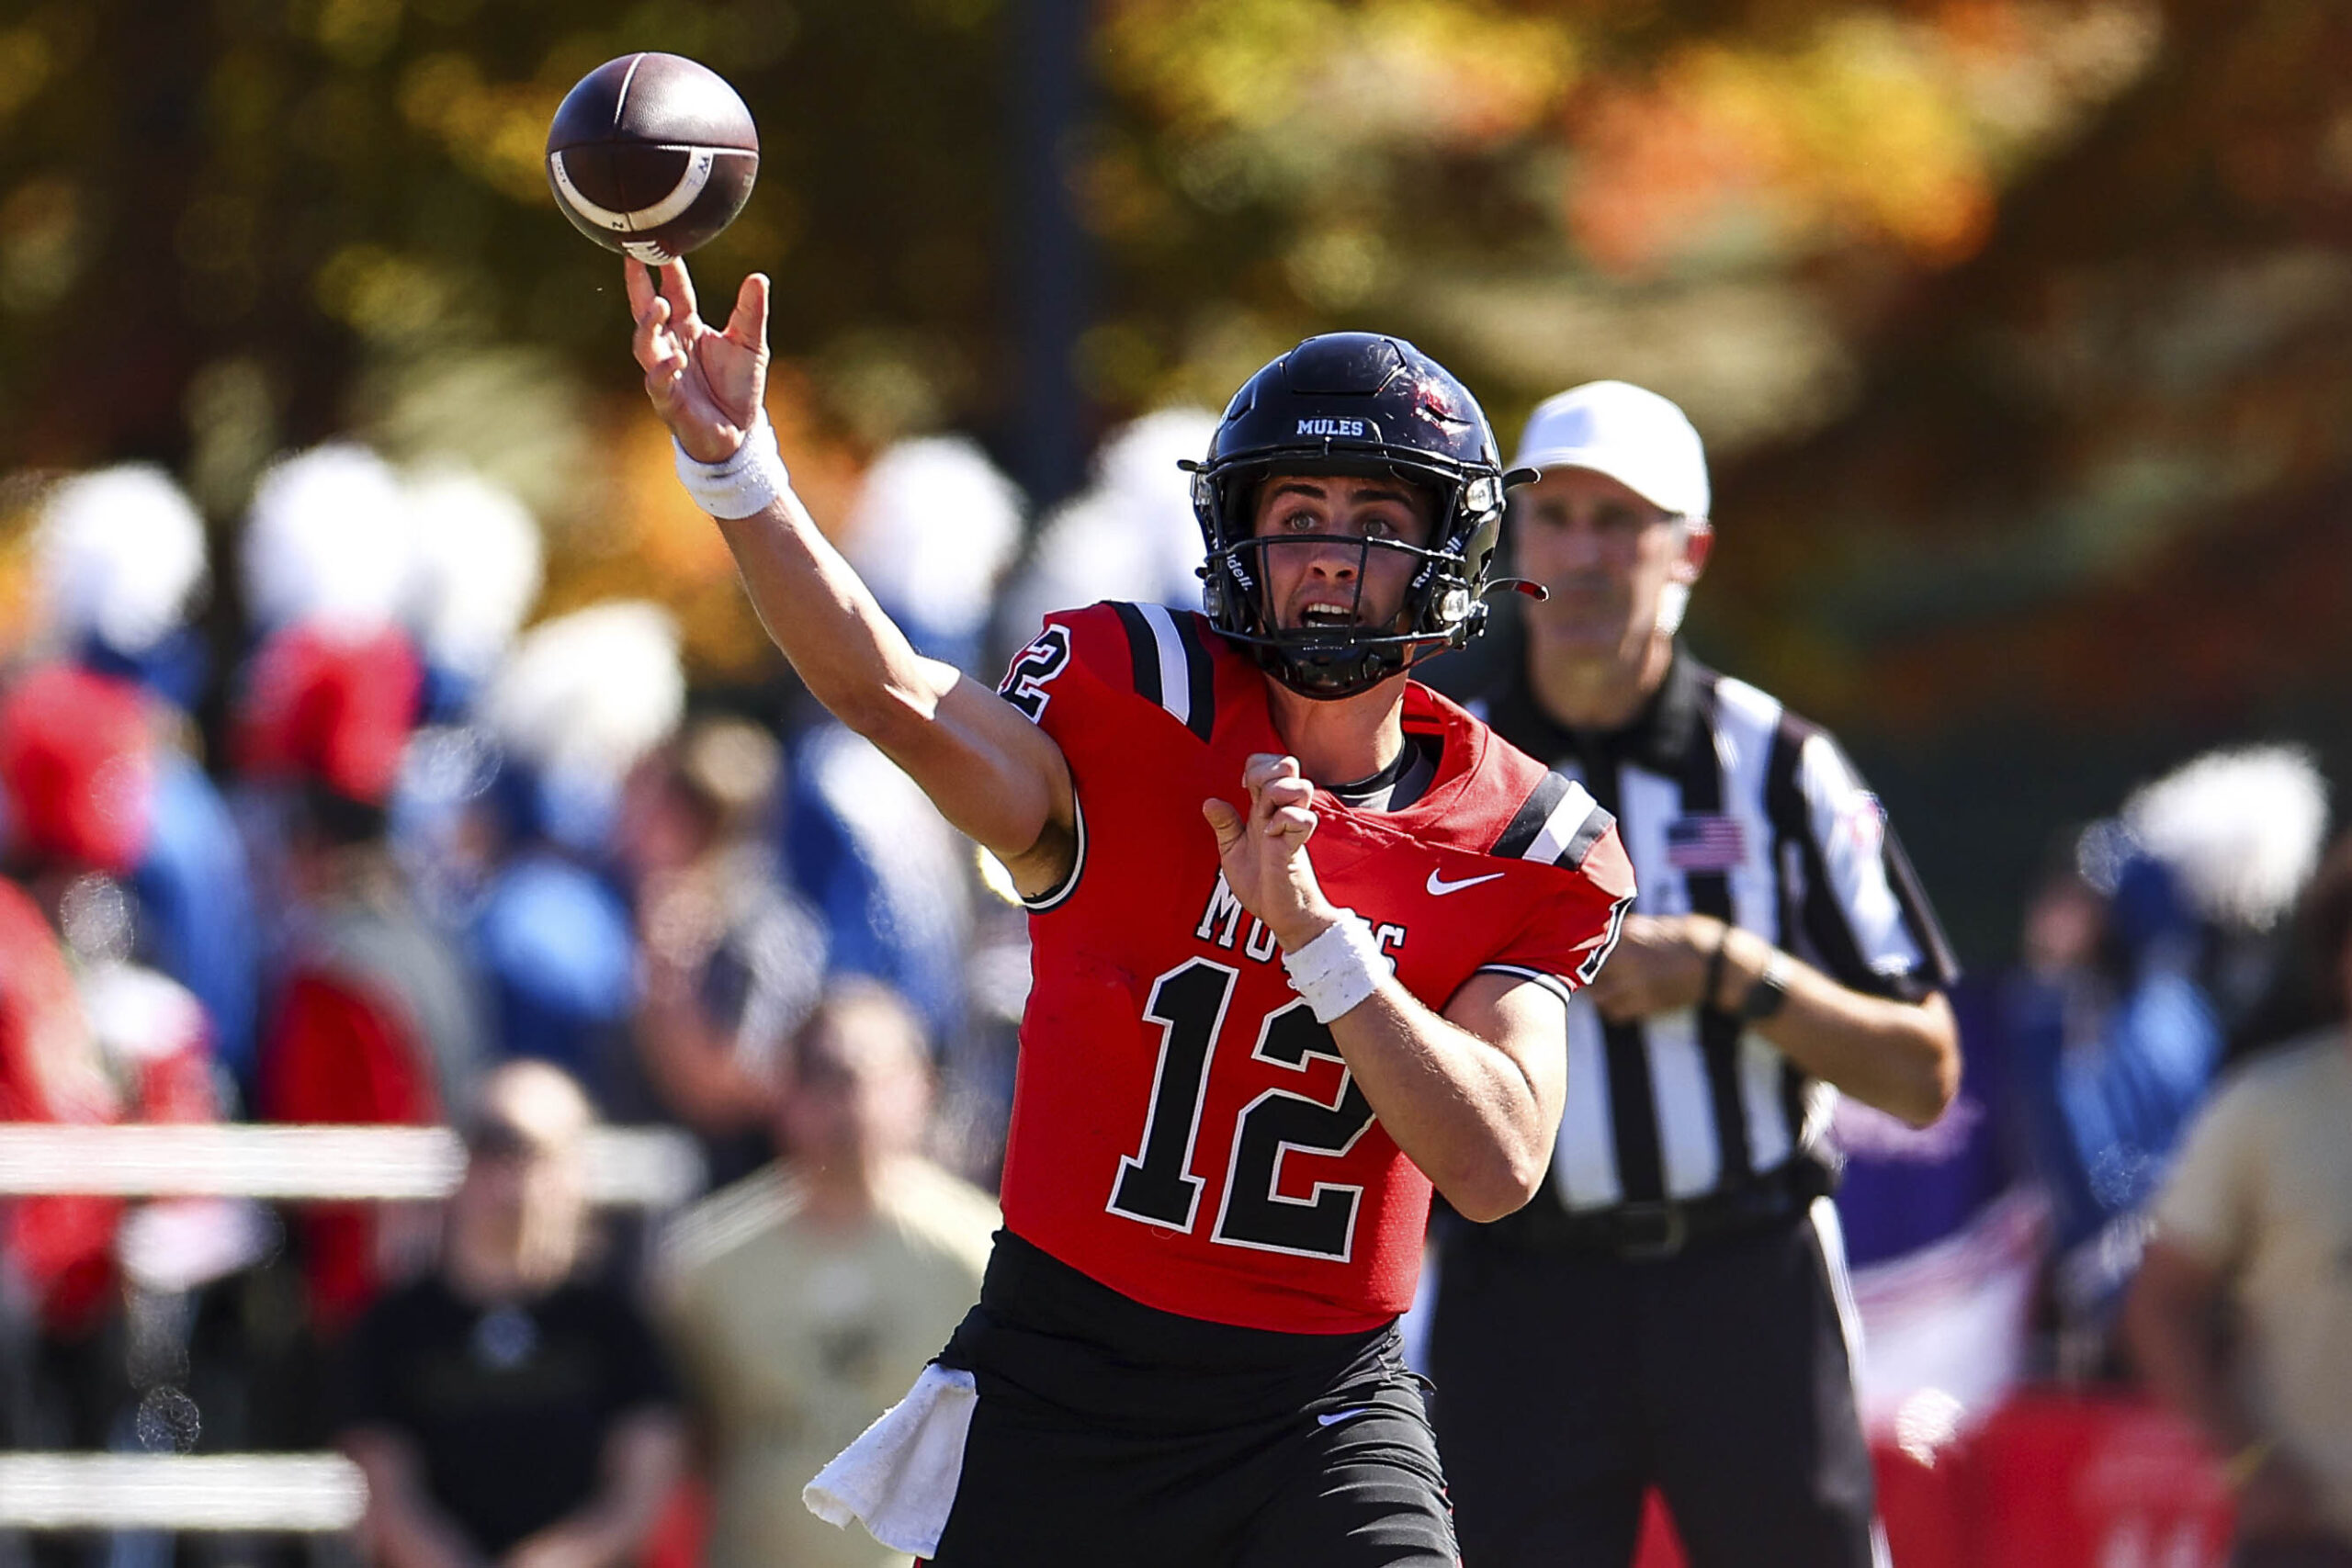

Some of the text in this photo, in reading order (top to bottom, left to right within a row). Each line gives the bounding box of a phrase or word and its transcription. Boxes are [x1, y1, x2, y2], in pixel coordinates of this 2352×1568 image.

[1296, 419, 1363, 436] MULES
[1196, 869, 1406, 977] MUS
[1105, 956, 1376, 1264] 12
